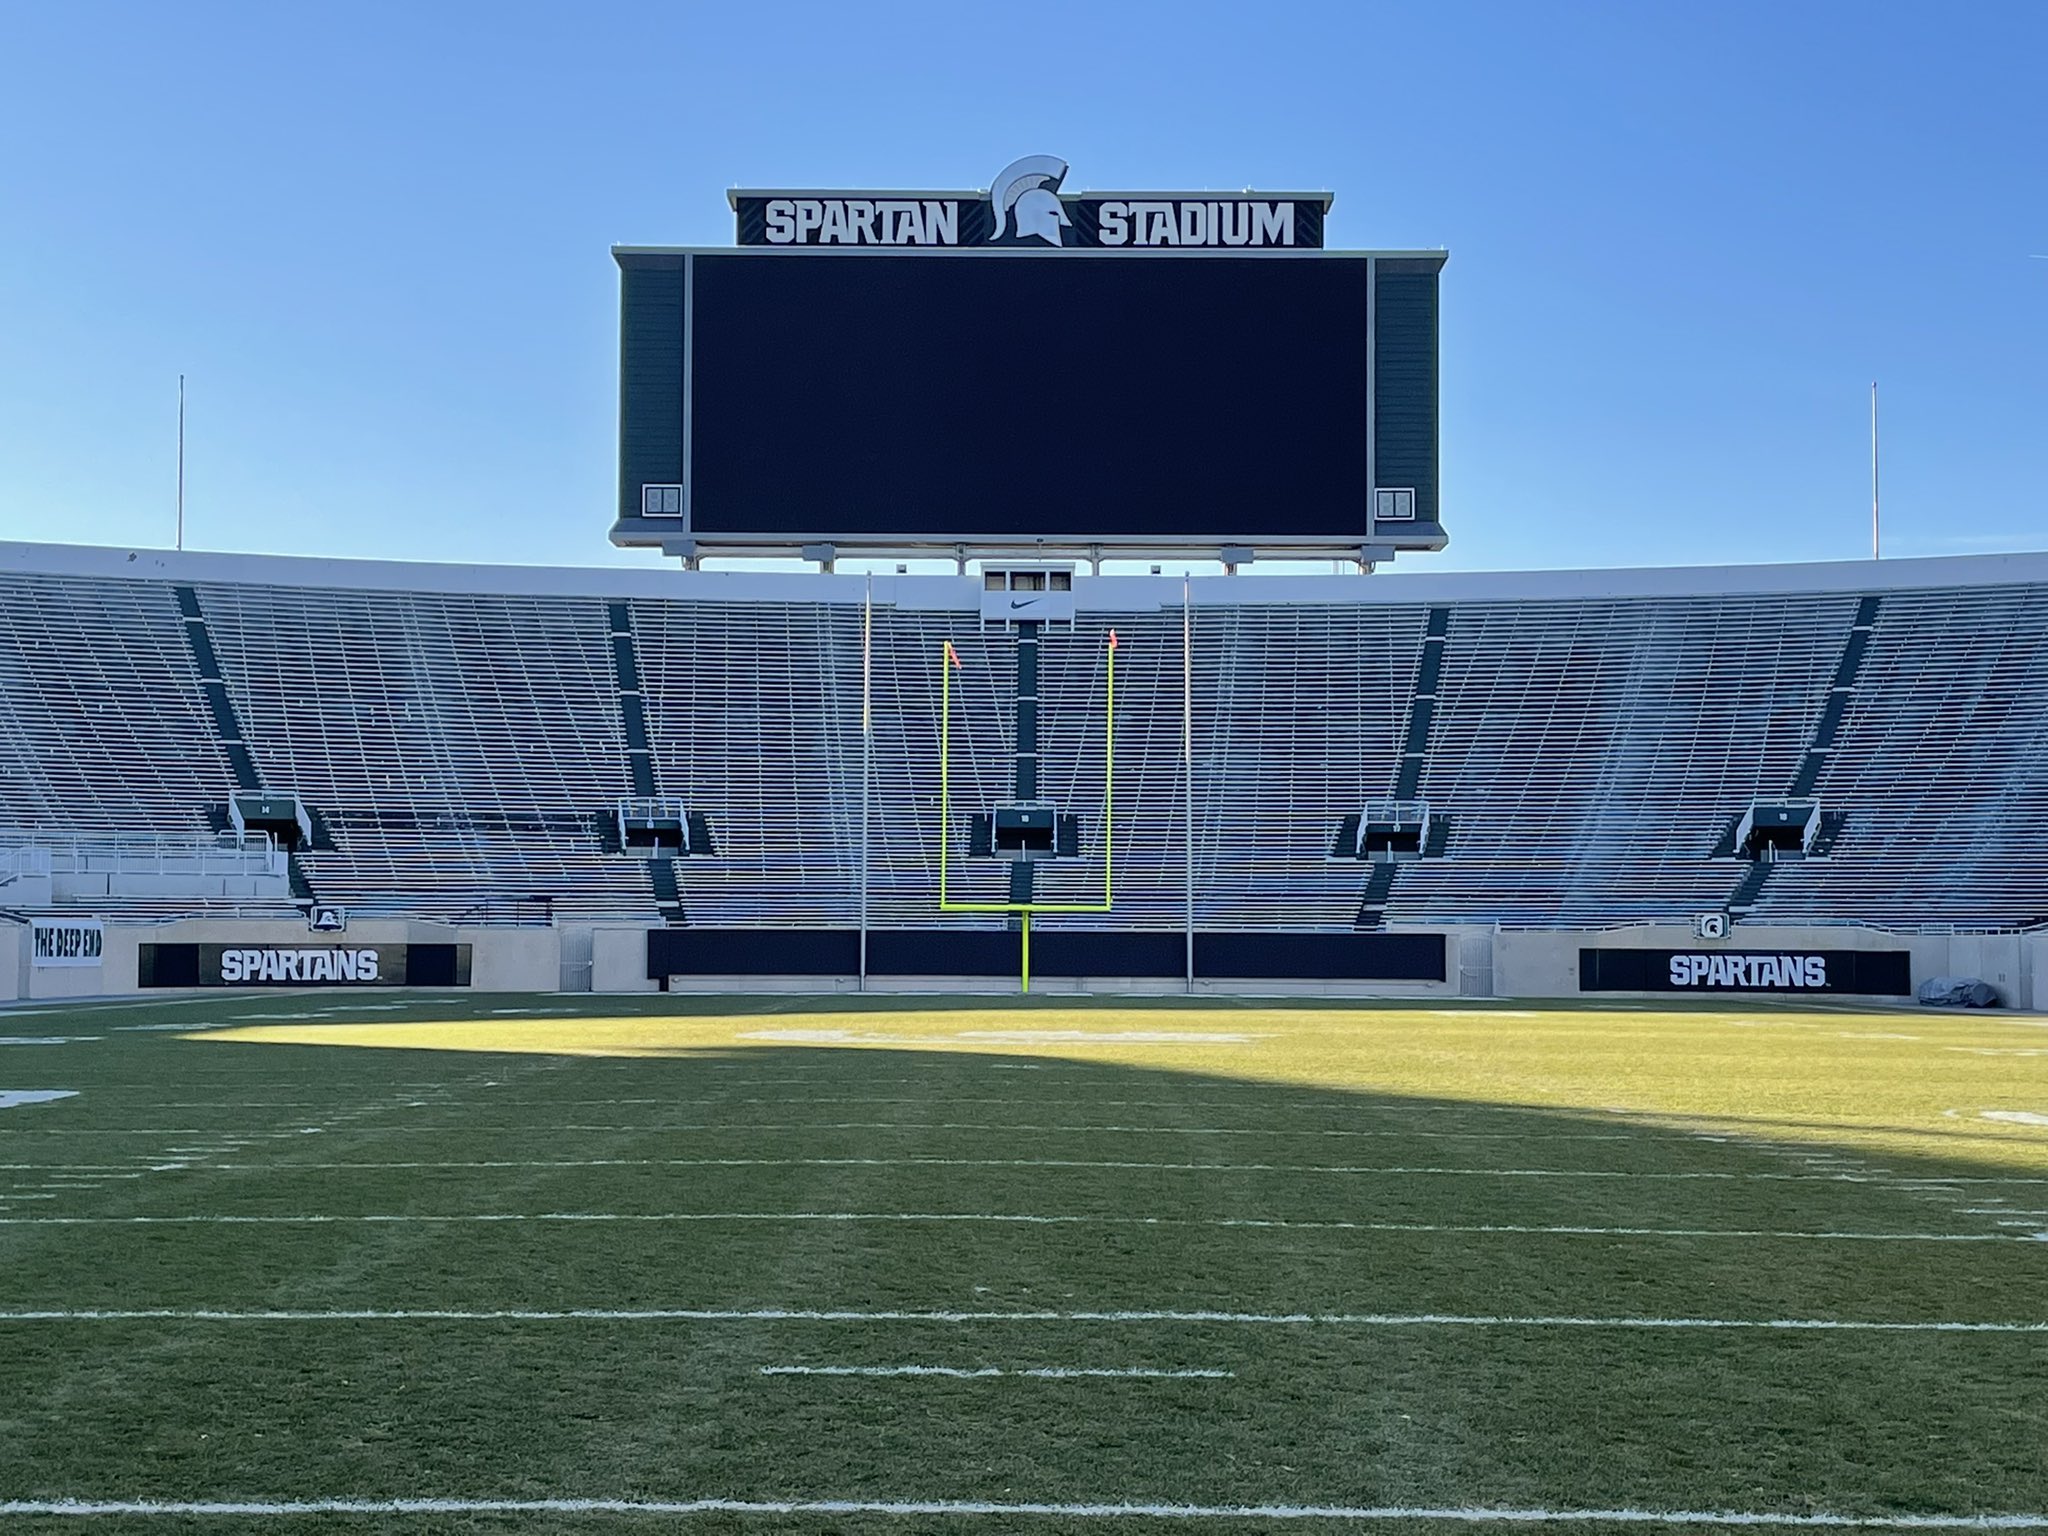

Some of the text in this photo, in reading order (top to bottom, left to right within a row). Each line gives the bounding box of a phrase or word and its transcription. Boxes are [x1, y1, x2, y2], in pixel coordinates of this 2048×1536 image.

[766, 200, 1295, 246] SPARTAN STADIUM
[35, 928, 102, 957] THE DEEP END
[221, 949, 379, 982] SPARTANS
[1669, 955, 1826, 988] SPARTANS
